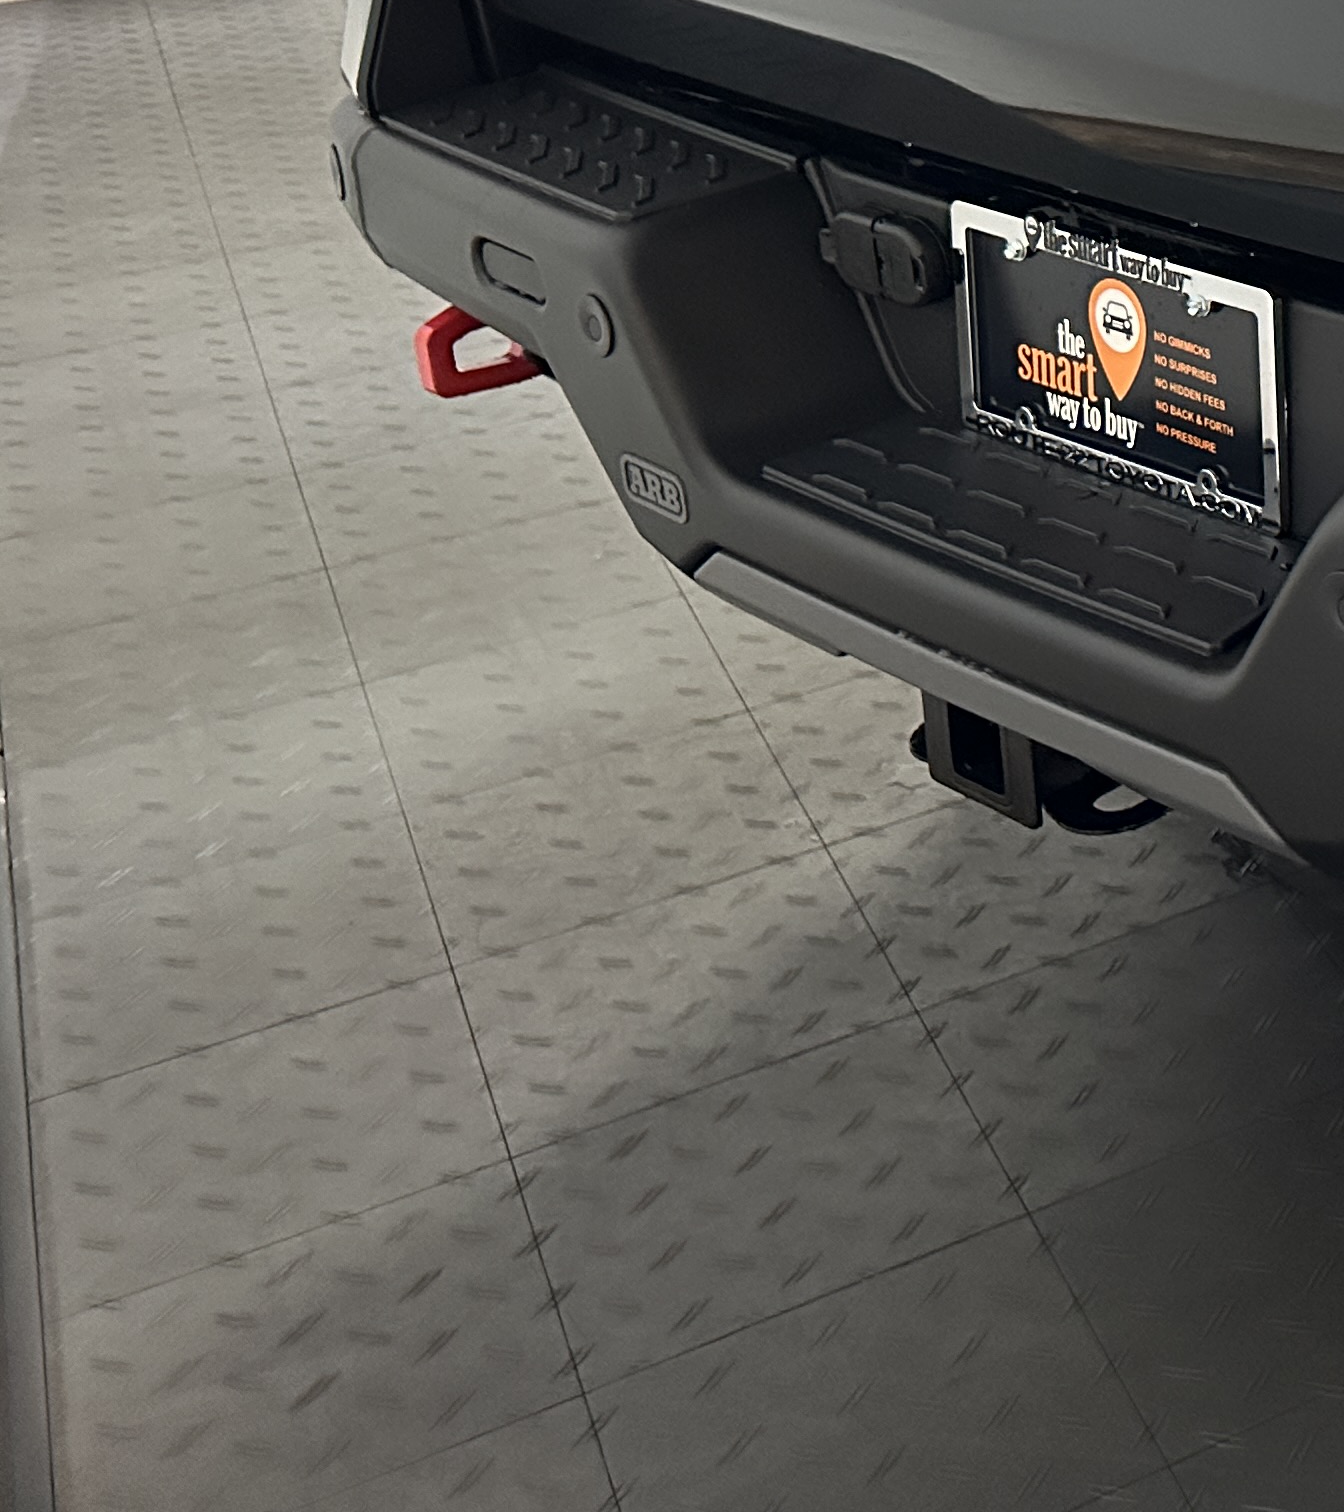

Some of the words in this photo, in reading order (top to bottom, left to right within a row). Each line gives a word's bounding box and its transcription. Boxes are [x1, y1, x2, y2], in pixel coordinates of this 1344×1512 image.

[1068, 234, 1120, 272] smart
[1120, 254, 1147, 282] way
[1145, 255, 1160, 283] to
[1161, 257, 1185, 292] buy
[1057, 318, 1086, 359] the
[1153, 330, 1167, 344] NO
[1168, 335, 1211, 360] GIMMICKS
[1017, 343, 1099, 403] smart
[1154, 353, 1168, 367] NO
[1169, 358, 1217, 385] SURPRISES
[1154, 376, 1168, 390] NO
[1169, 382, 1202, 403] HIDDEN
[1203, 394, 1226, 411] FEES
[1045, 391, 1081, 430] way
[1082, 396, 1102, 432] to
[1104, 397, 1138, 449] buy
[1155, 399, 1169, 413] NO
[1170, 404, 1195, 423] BACK
[1195, 414, 1203, 426] &
[1204, 417, 1234, 437] FORTH
[1155, 422, 1170, 436] NO
[1170, 428, 1217, 455] PRESSURE
[626, 461, 683, 516] ARB
